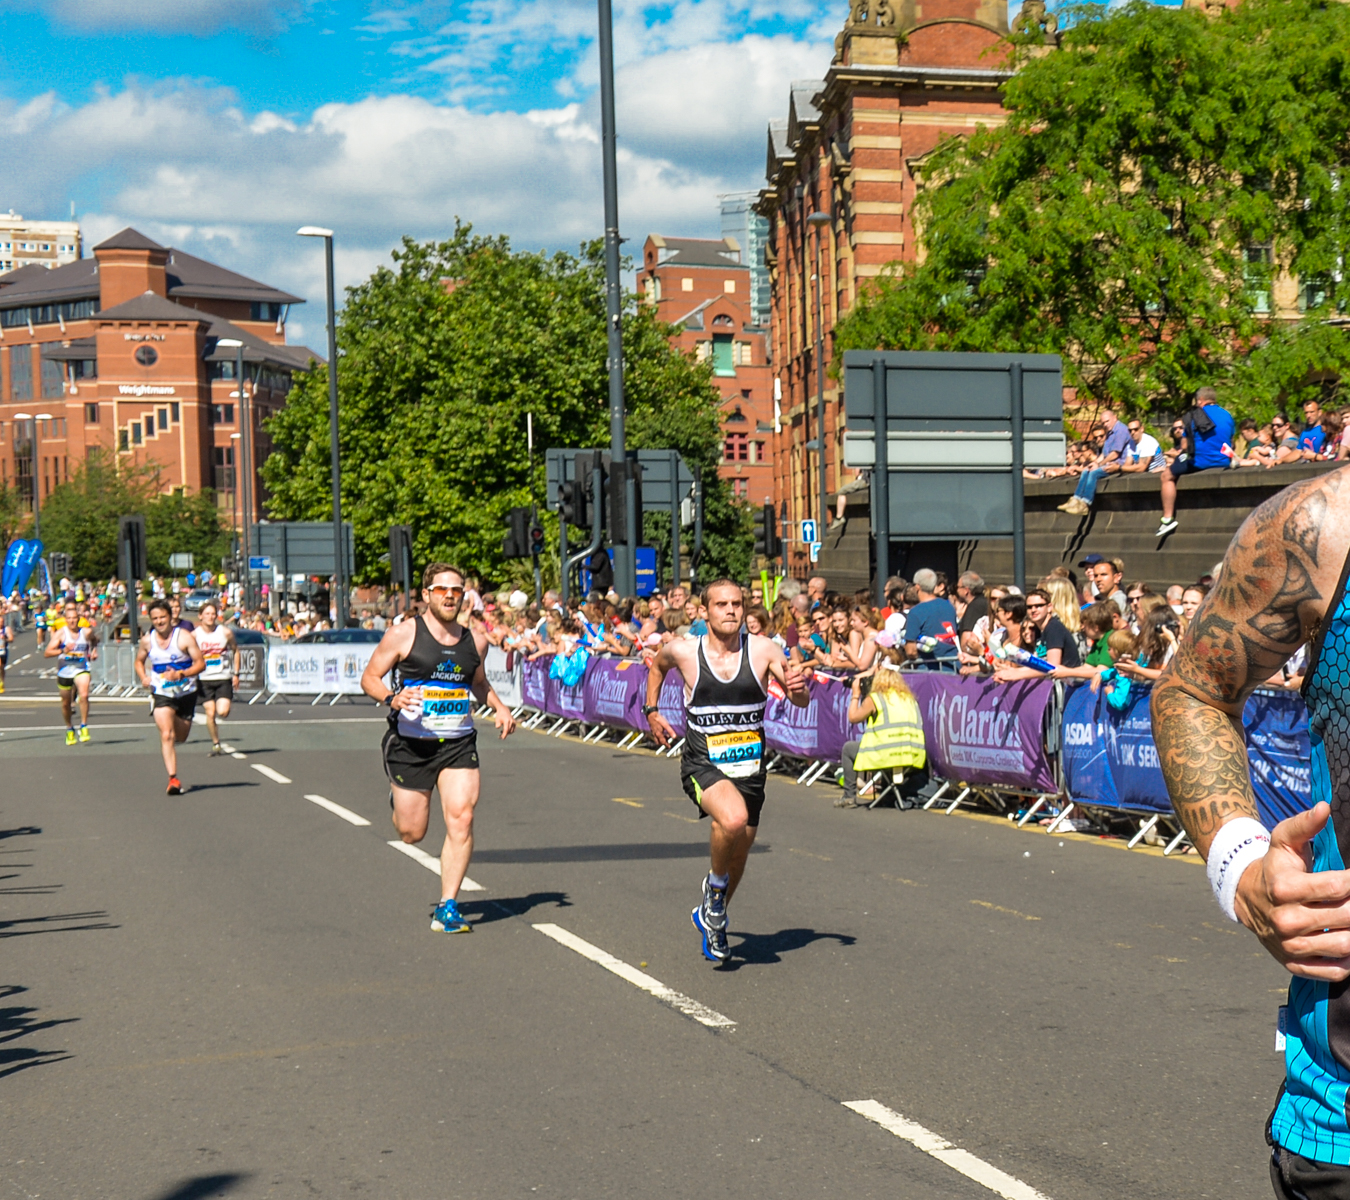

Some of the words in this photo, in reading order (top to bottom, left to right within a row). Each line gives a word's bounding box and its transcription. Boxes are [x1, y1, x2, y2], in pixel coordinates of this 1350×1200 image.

[118, 384, 175, 397] Weightmans
[288, 656, 318, 673] Leeds
[431, 671, 466, 681] JACKPOT
[430, 702, 463, 713] 4600
[697, 713, 735, 726] OTLEY
[738, 712, 761, 724] A.C.
[948, 694, 1022, 748] Clarion
[711, 738, 728, 746] RUN
[730, 736, 743, 744] FOR
[1064, 723, 1093, 746] ASDA
[719, 746, 755, 763] 4429
[1138, 744, 1161, 768] SER
